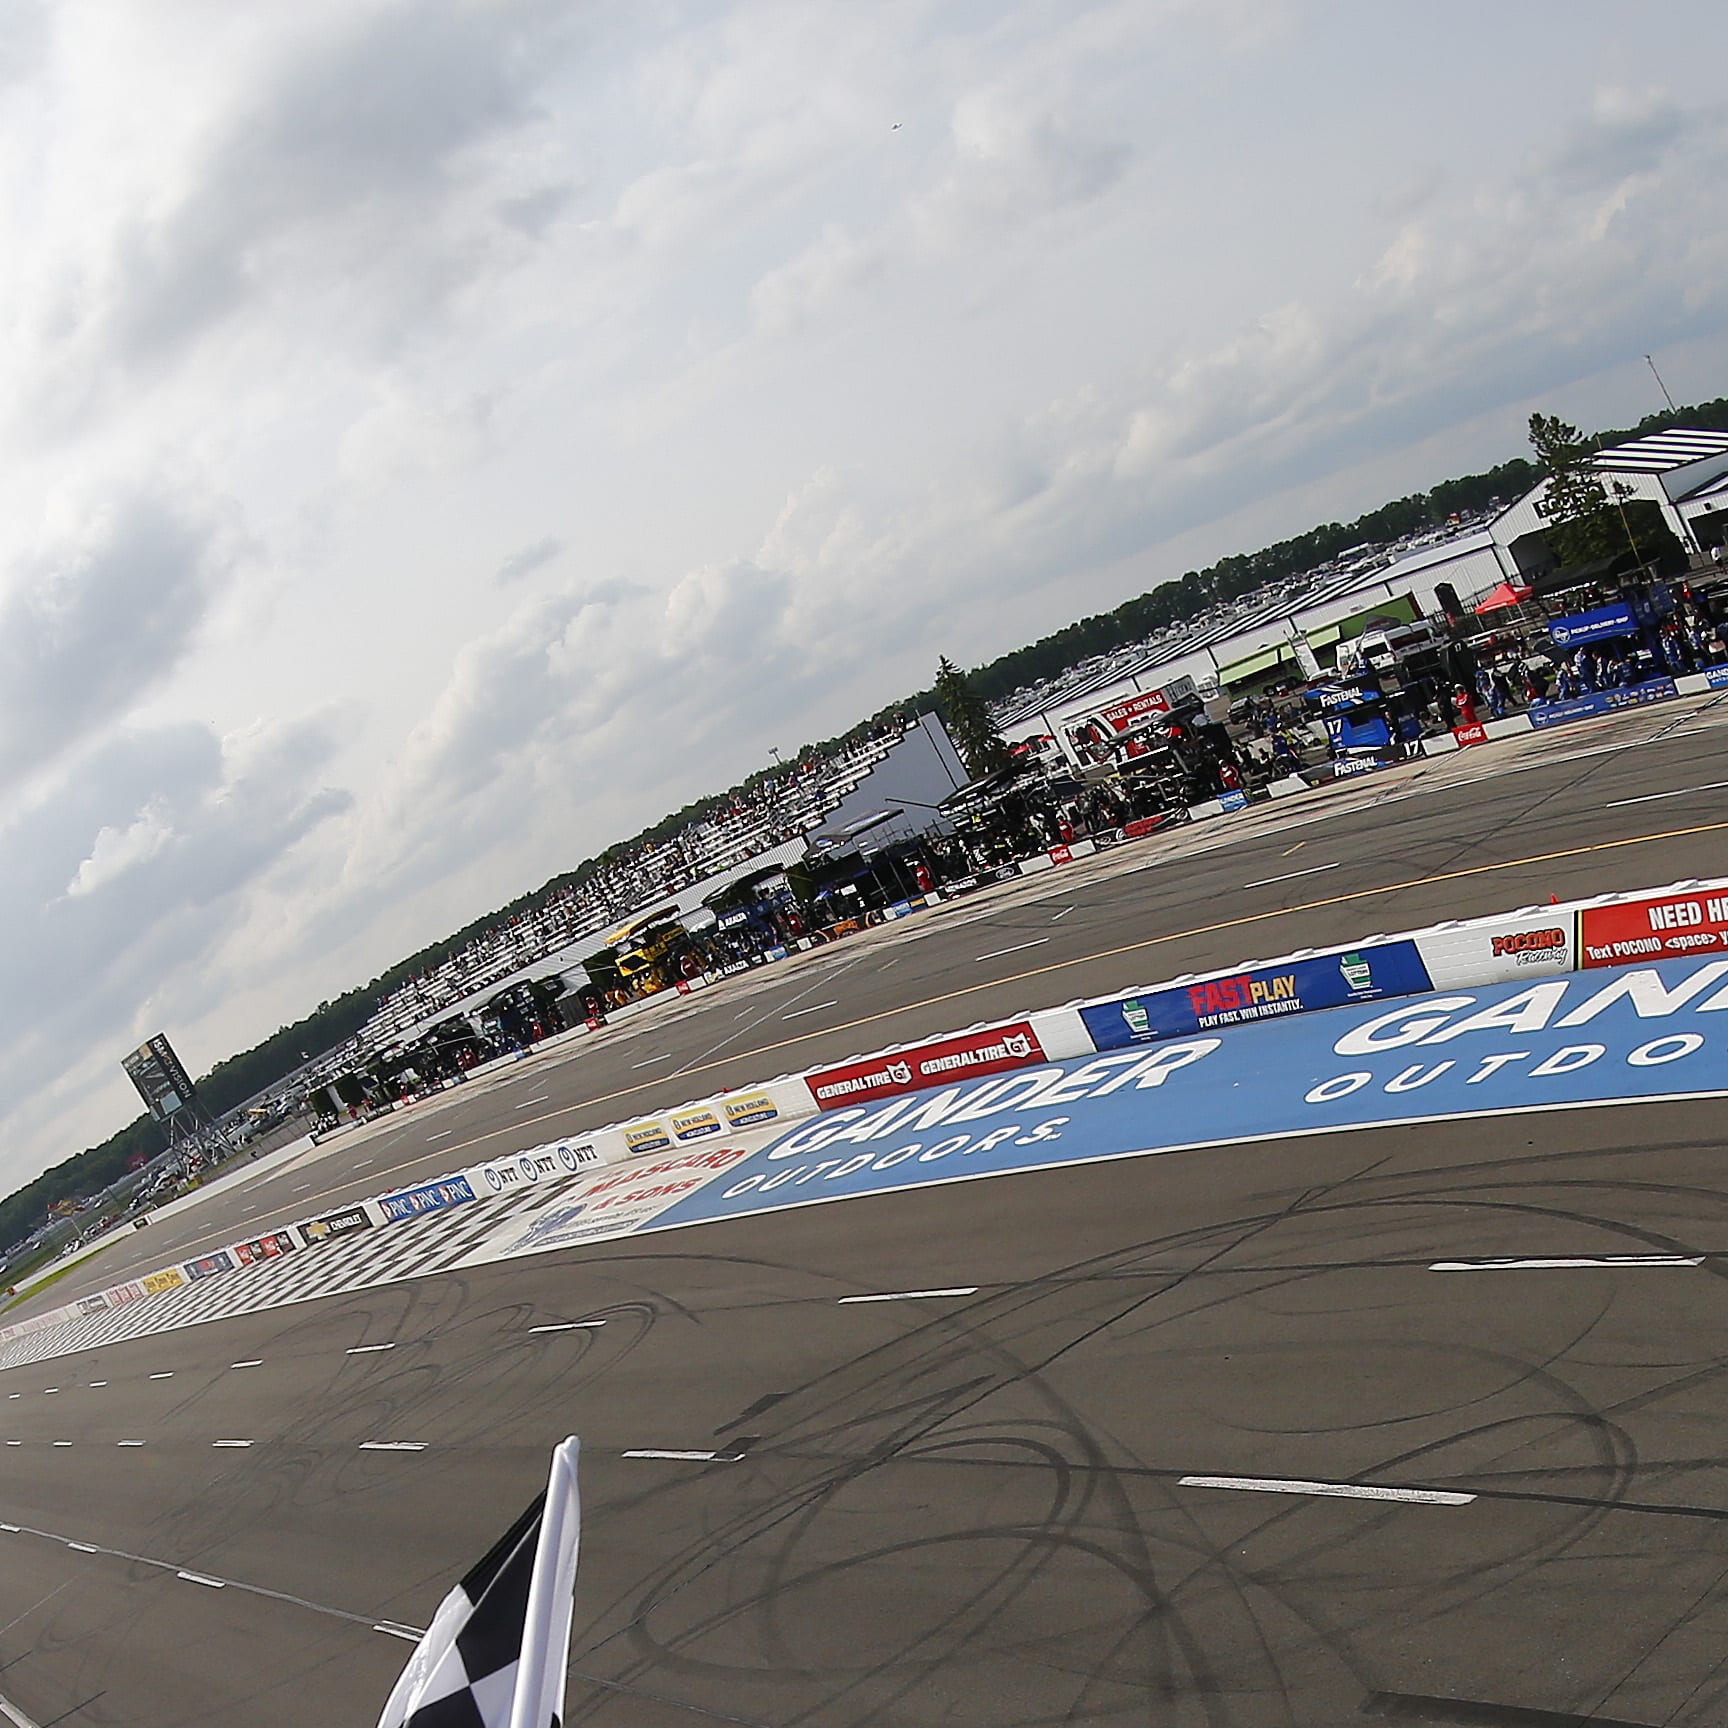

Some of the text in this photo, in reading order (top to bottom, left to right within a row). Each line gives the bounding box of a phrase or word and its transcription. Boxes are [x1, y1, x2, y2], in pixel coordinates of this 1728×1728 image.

[1321, 687, 1364, 708] FASTENAL
[1106, 694, 1164, 723] SALES RENTALS
[1327, 718, 1342, 735] 17
[1404, 740, 1421, 757] 17
[1334, 755, 1377, 777] FASTENAL
[725, 911, 748, 928] AXALTA
[1648, 900, 1703, 931] NEED
[1491, 928, 1567, 956] POCONO
[1586, 943, 1613, 962] Text
[1614, 936, 1662, 959] POCONO
[1664, 931, 1717, 953] <space>
[723, 959, 749, 975] AXALTA
[1186, 973, 1297, 1016] FAST PLAY
[1198, 1012, 1218, 1028] PLAY
[1239, 1006, 1259, 1020] WIN
[1258, 998, 1304, 1017] INSTANTLY.
[920, 1045, 1010, 1076] GENERAL TIRE
[816, 1073, 892, 1099] GENERAL TIRE
[766, 1037, 1223, 1162] GANDER
[576, 1144, 599, 1163] NTT
[721, 1116, 1070, 1200] OUTDOORS
[500, 1167, 520, 1183] NTT
[536, 1156, 557, 1174] NTT
[417, 1189, 441, 1208] PNC
[448, 1181, 473, 1200] PNC
[391, 1198, 411, 1217] PNC
